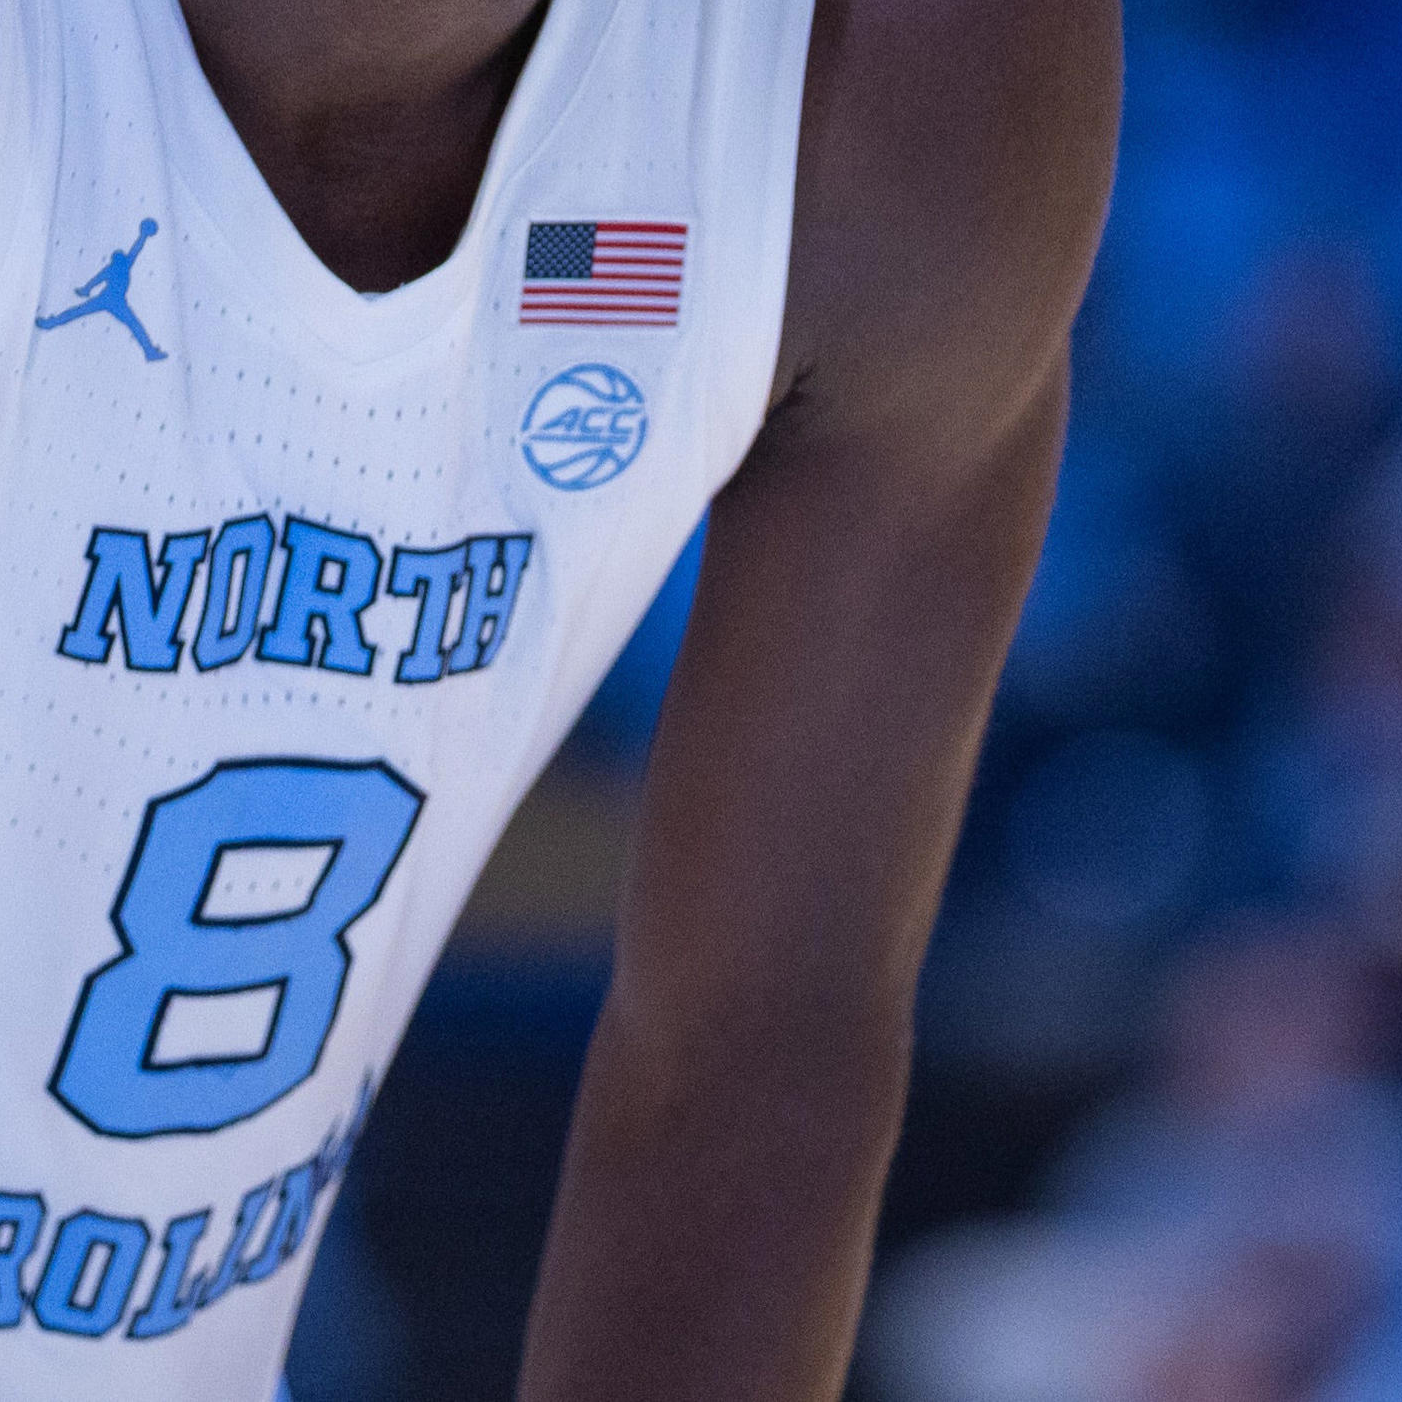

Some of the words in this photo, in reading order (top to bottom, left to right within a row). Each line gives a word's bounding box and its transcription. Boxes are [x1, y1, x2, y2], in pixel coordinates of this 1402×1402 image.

[540, 406, 643, 434] ACC
[57, 513, 534, 685] NORTH
[47, 756, 427, 1139] 8
